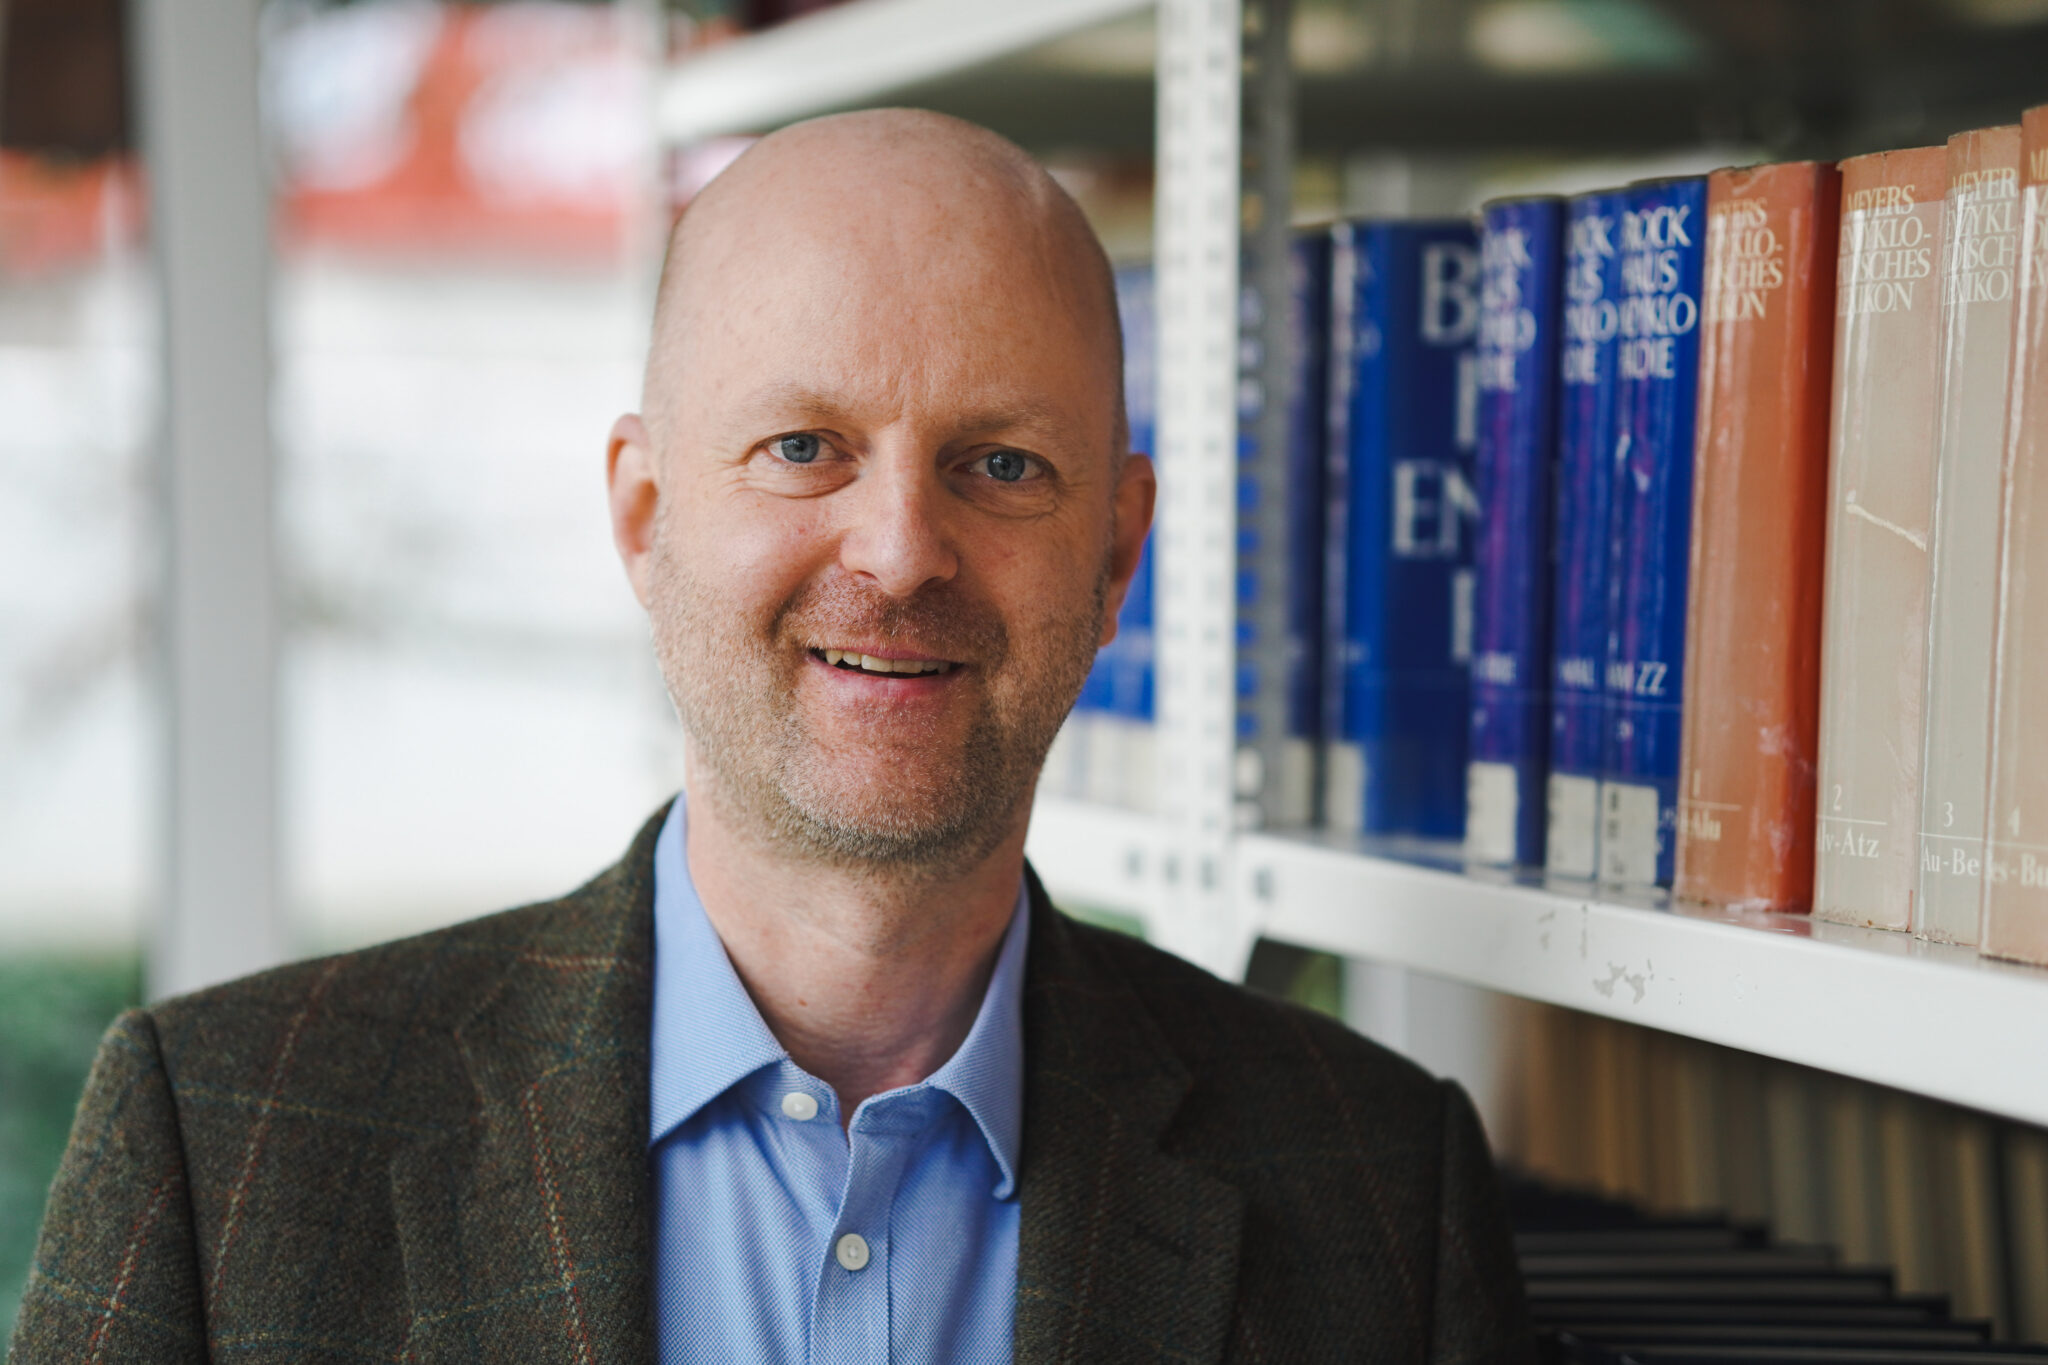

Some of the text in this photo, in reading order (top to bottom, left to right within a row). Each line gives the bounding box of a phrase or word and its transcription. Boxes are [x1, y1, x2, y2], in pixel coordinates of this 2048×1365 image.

[1846, 184, 1916, 219] MEYERS
[1832, 783, 1843, 812] 2
[1943, 801, 1954, 829] 3
